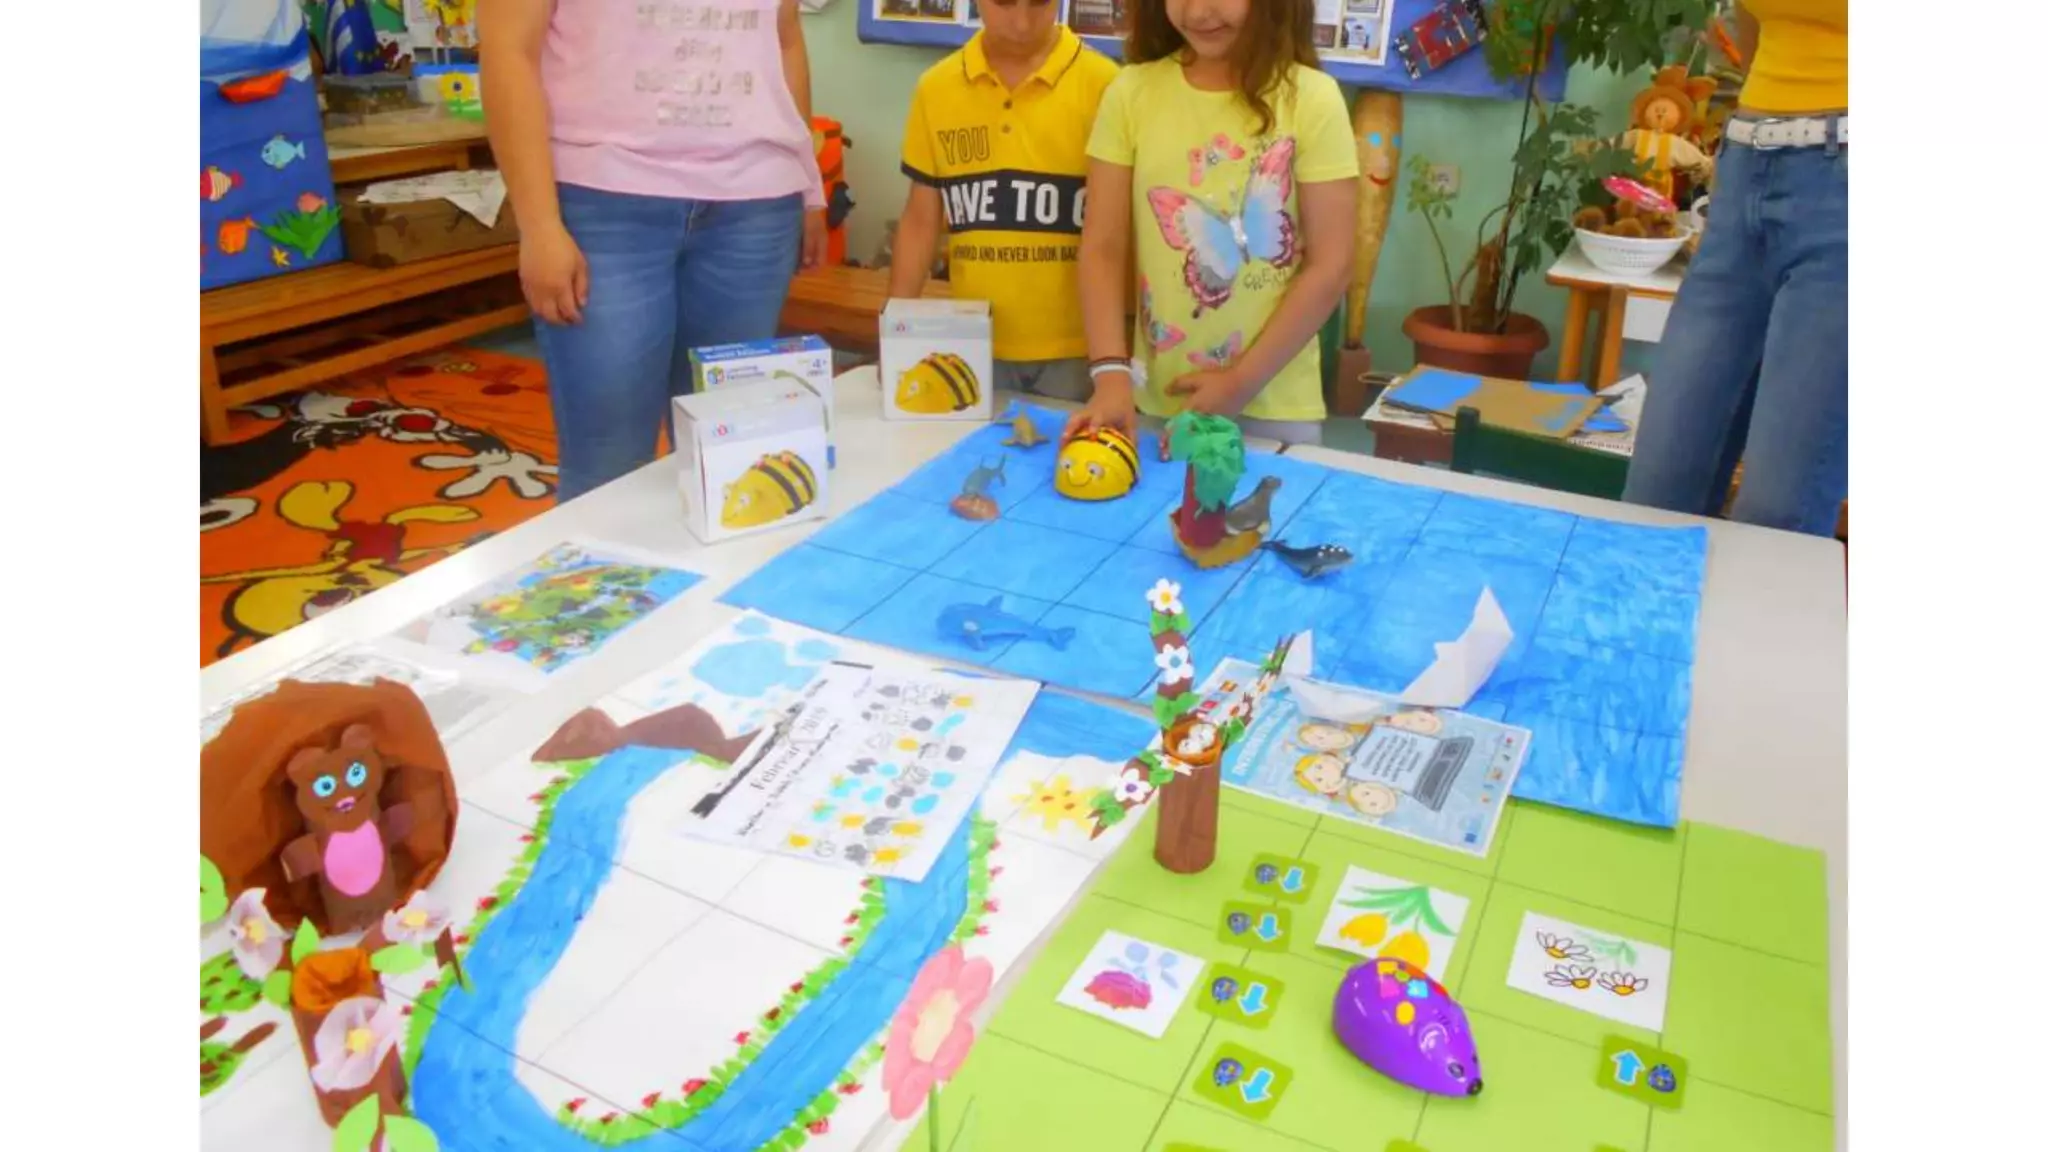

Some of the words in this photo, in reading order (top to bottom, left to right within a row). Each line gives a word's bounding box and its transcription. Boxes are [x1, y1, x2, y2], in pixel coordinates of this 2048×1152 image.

[937, 125, 990, 166] YOU
[1011, 179, 1059, 225] TO
[997, 245, 1029, 263] NEVER
[1032, 245, 1058, 263] LOOK
